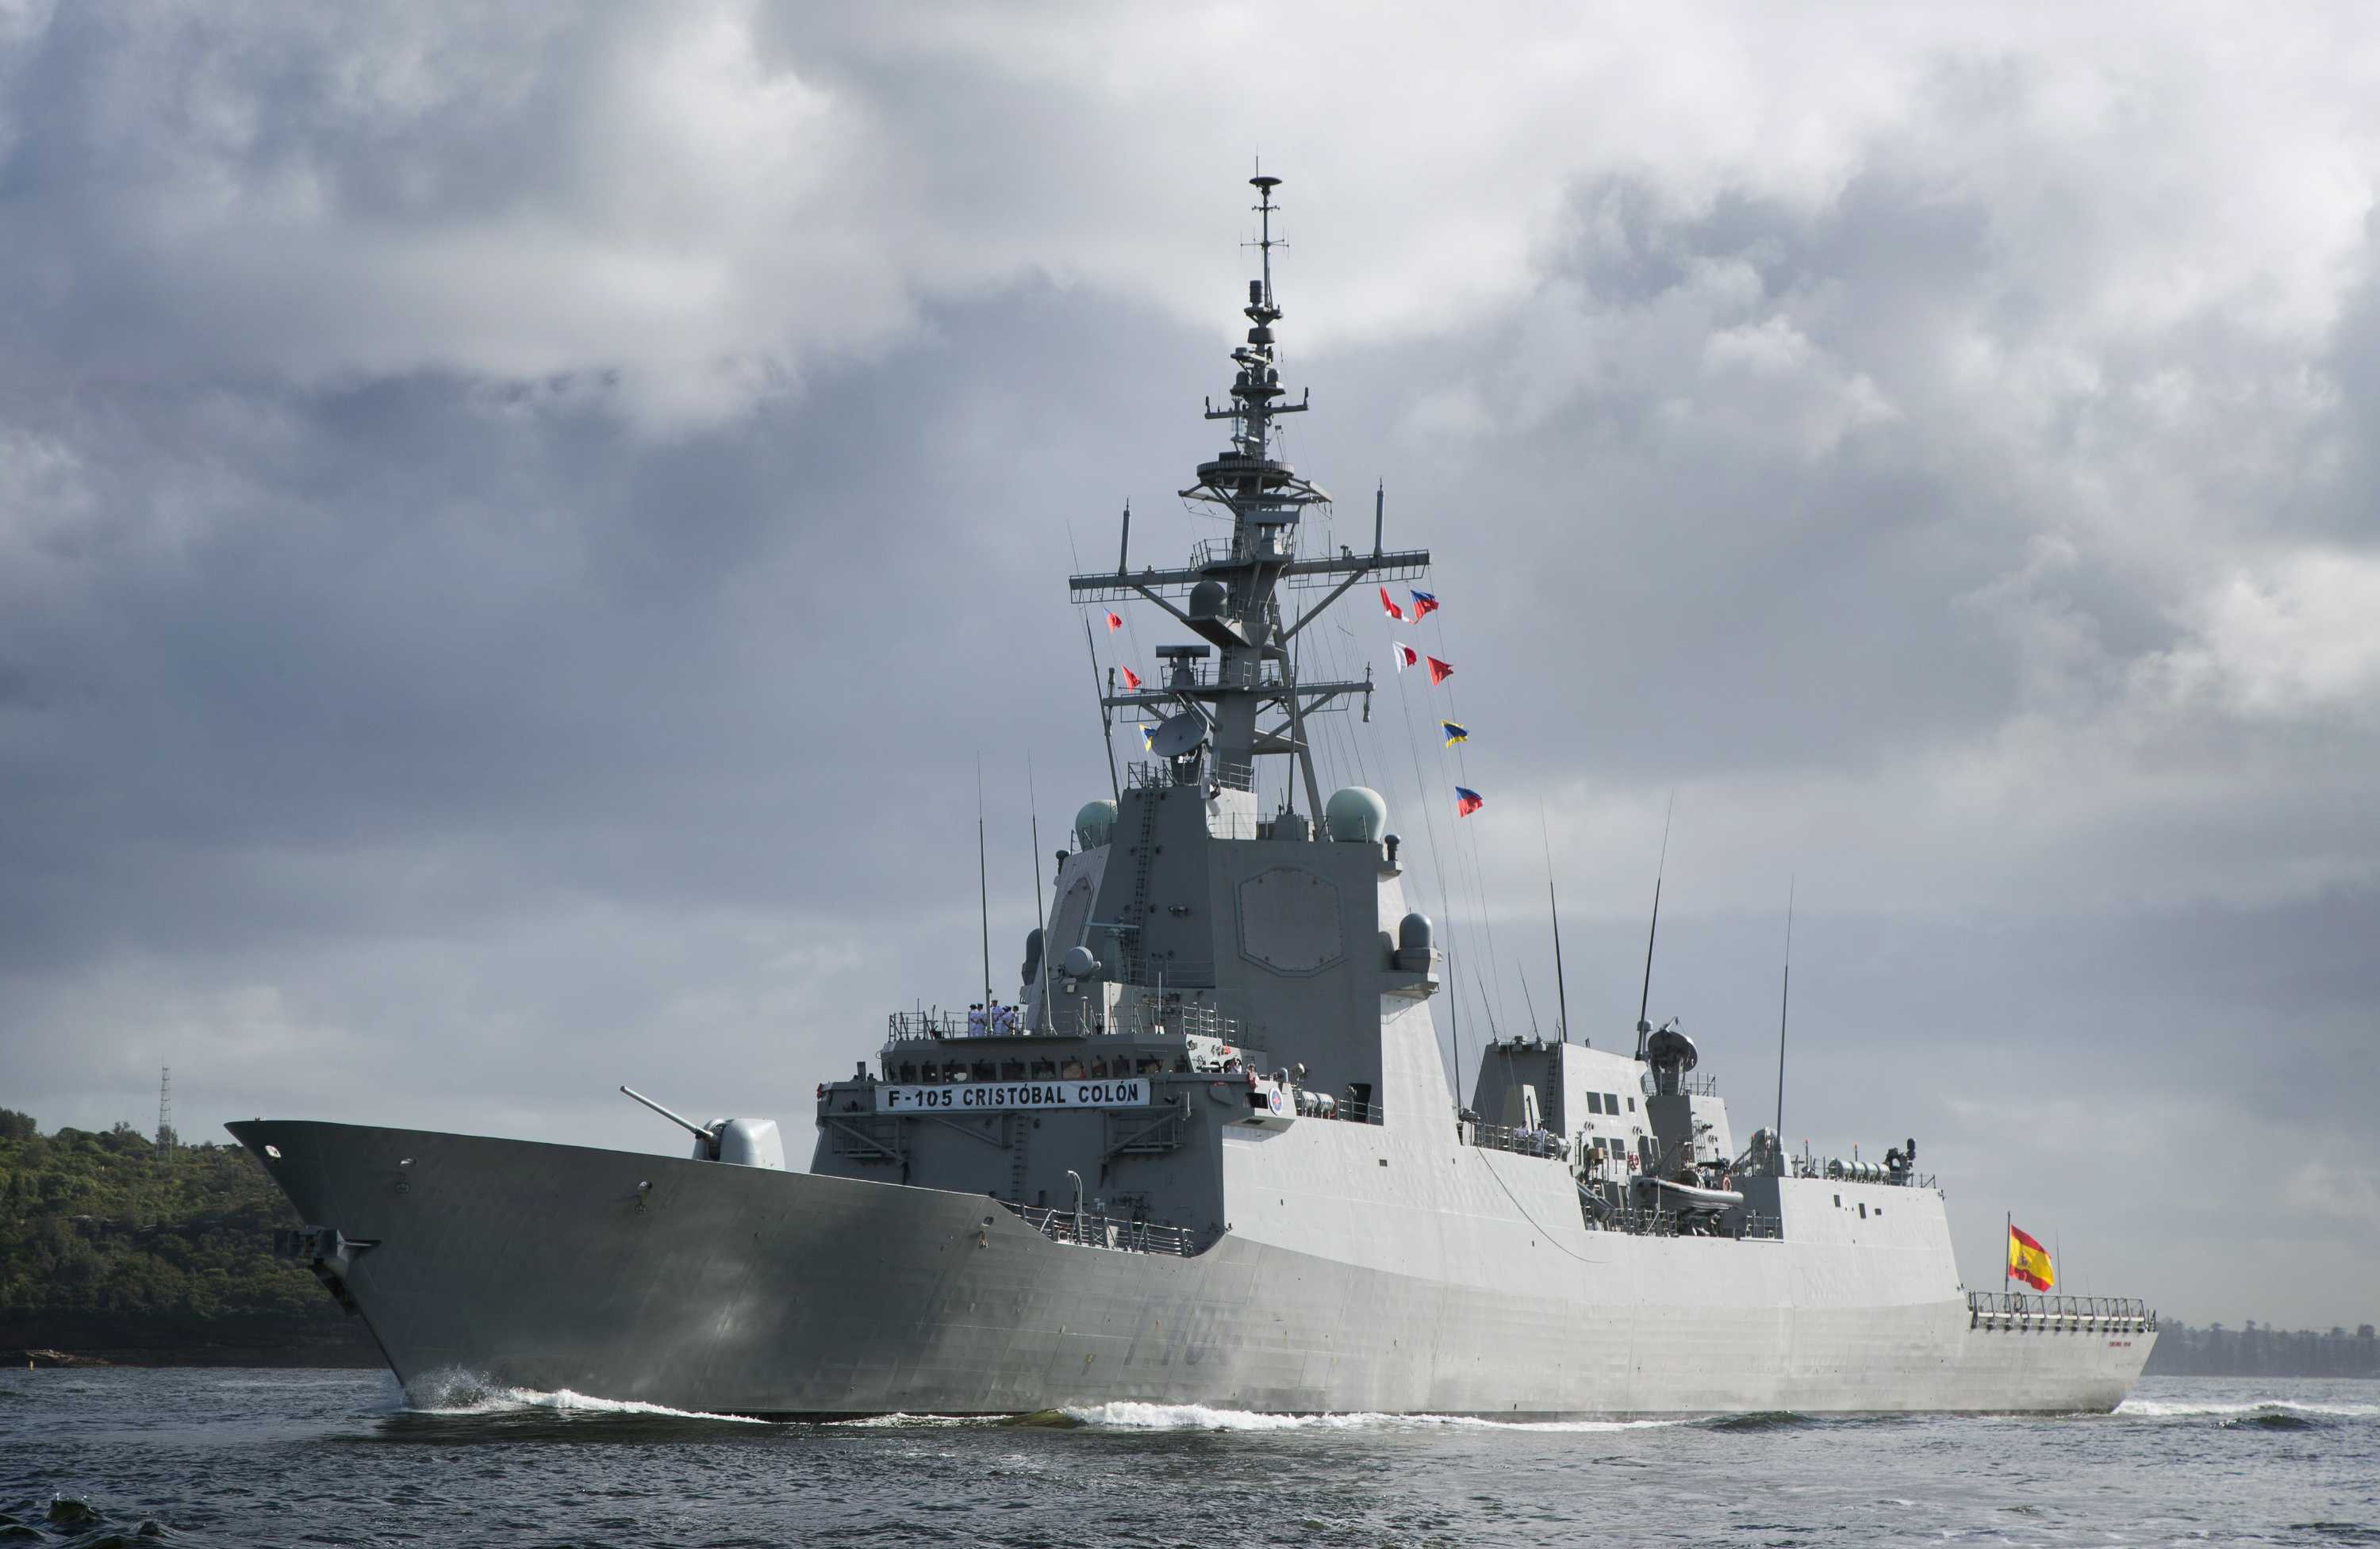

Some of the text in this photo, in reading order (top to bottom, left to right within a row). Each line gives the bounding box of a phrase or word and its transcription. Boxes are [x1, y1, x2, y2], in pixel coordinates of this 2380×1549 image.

[888, 1081, 1138, 1107] F-105 CRISTÓBAL COLÓN
